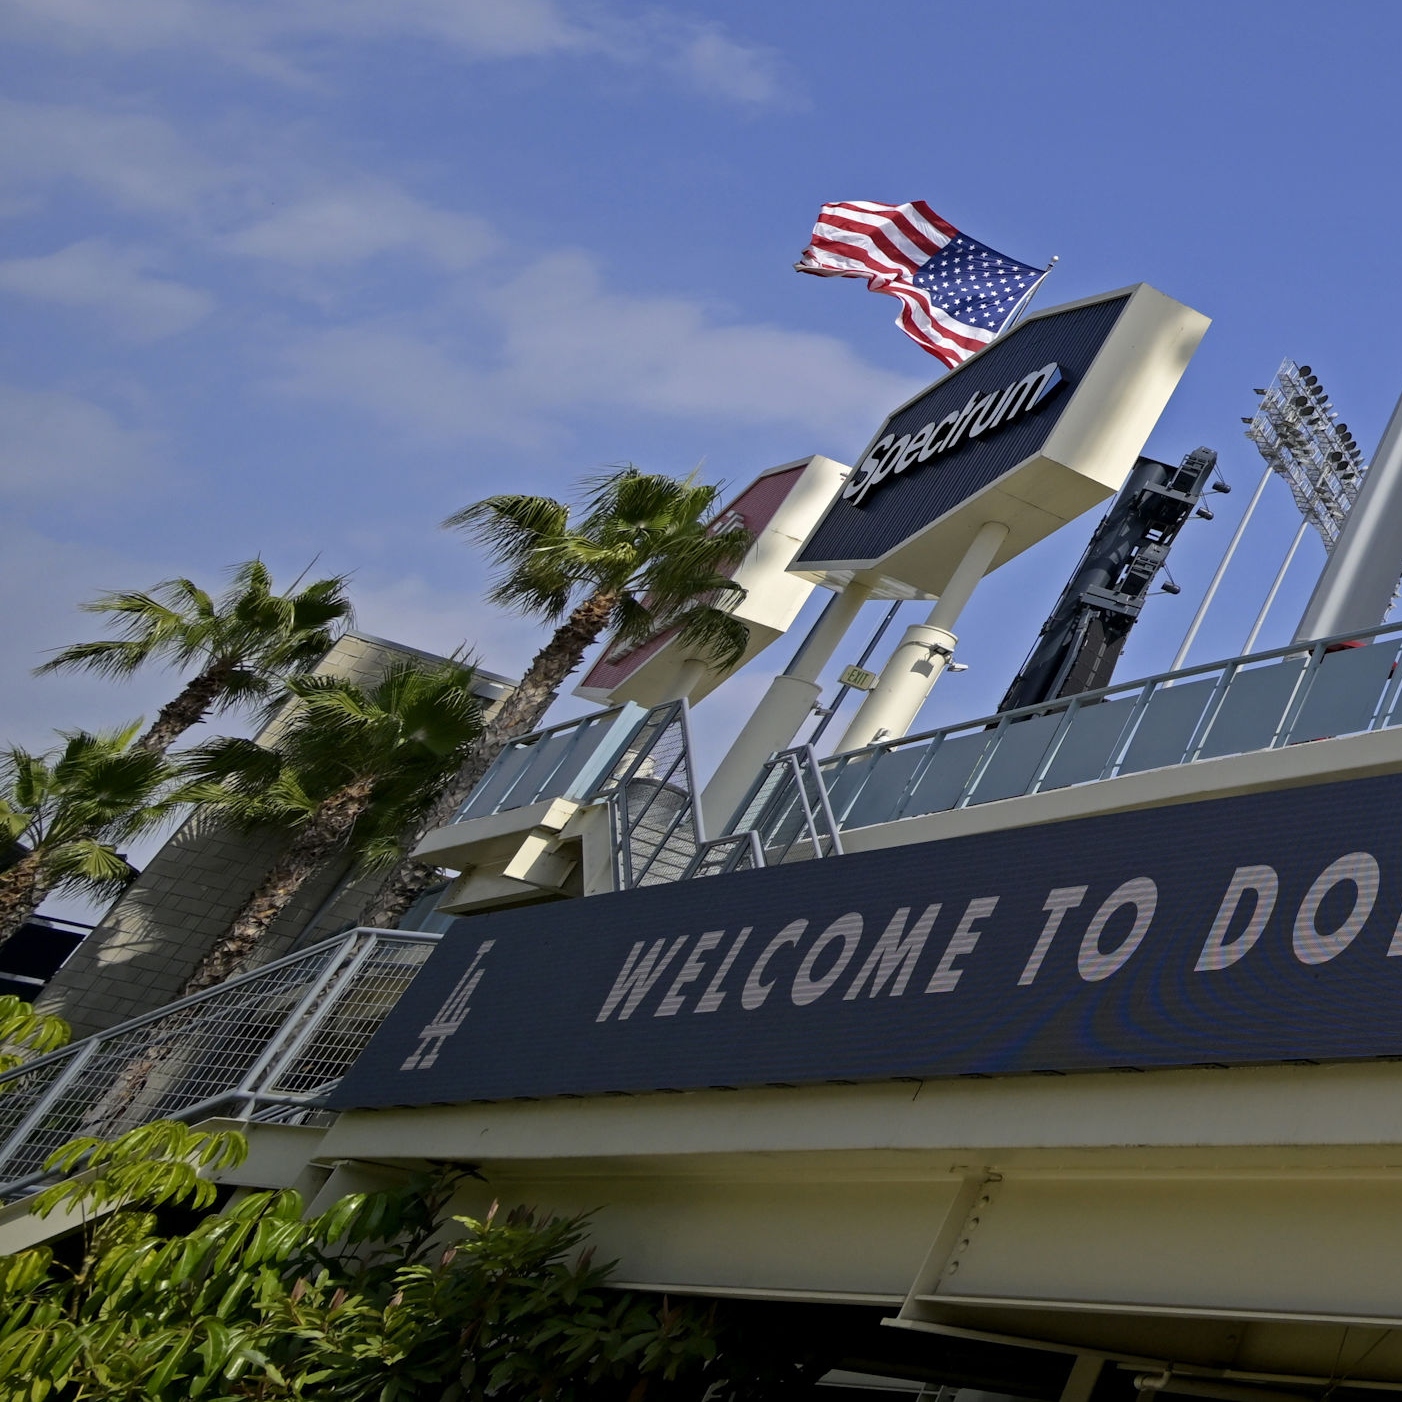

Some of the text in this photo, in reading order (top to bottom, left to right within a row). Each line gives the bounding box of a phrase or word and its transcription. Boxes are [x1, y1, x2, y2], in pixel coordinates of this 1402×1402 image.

[843, 361, 1060, 507] Spectrum
[847, 668, 870, 686] EXIT
[597, 895, 1000, 1023] WELCOME
[1017, 876, 1158, 986] TO
